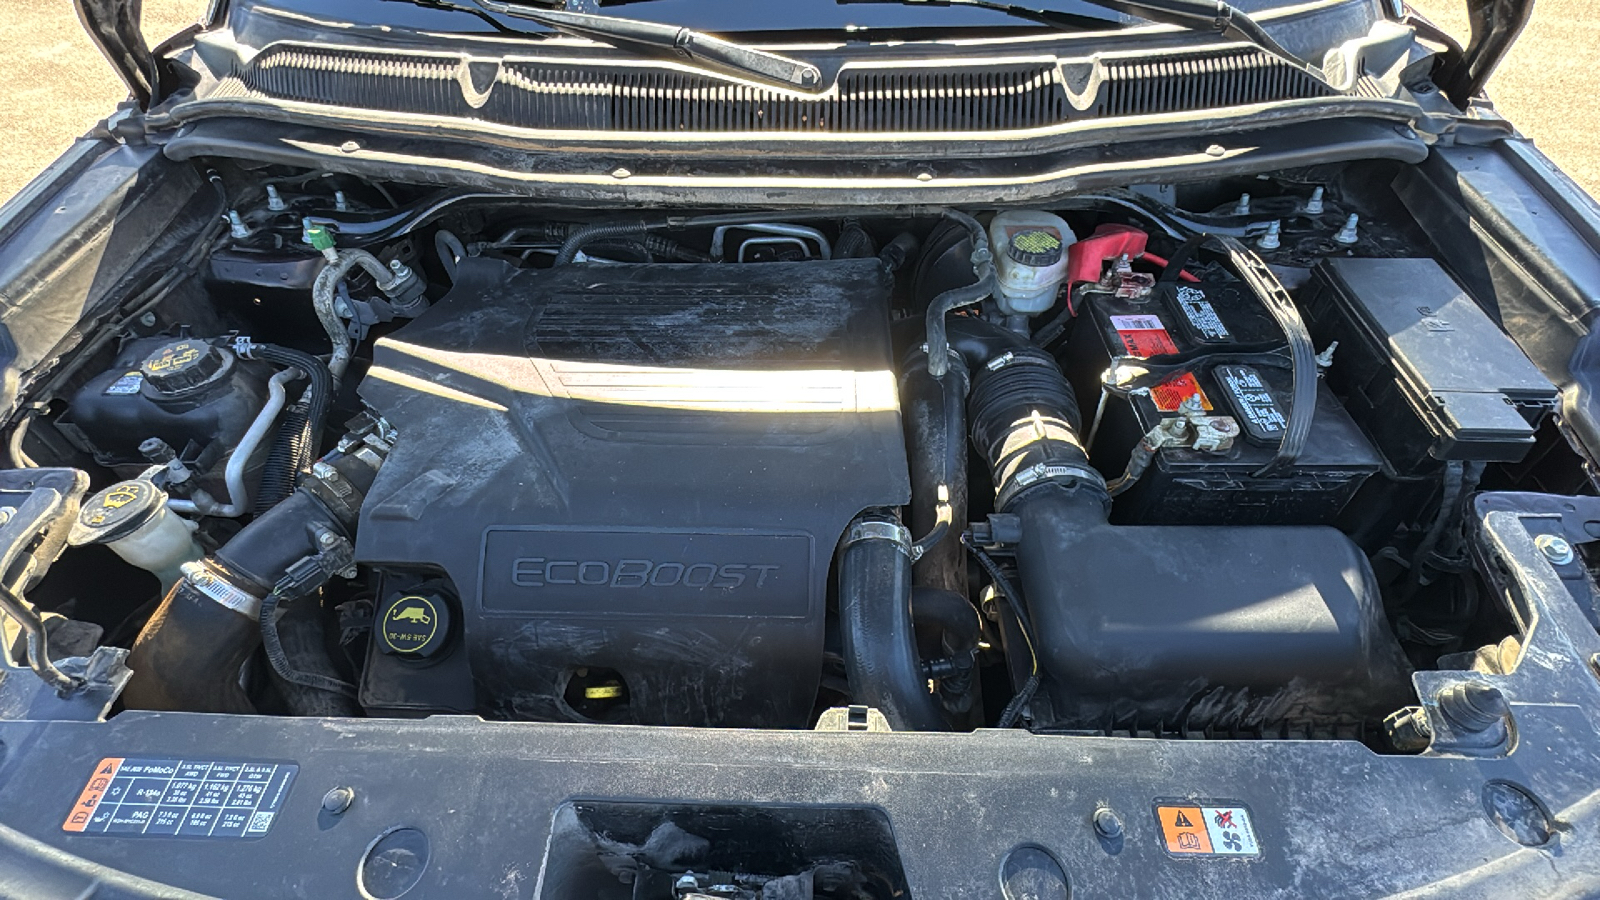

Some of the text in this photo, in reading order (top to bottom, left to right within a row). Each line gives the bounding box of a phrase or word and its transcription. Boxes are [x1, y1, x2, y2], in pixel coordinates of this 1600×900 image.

[388, 632, 427, 642] SAE 5W-30
[143, 765, 174, 774] FoMoCo
[136, 788, 161, 797] R-134a
[131, 811, 149, 819] PAG
